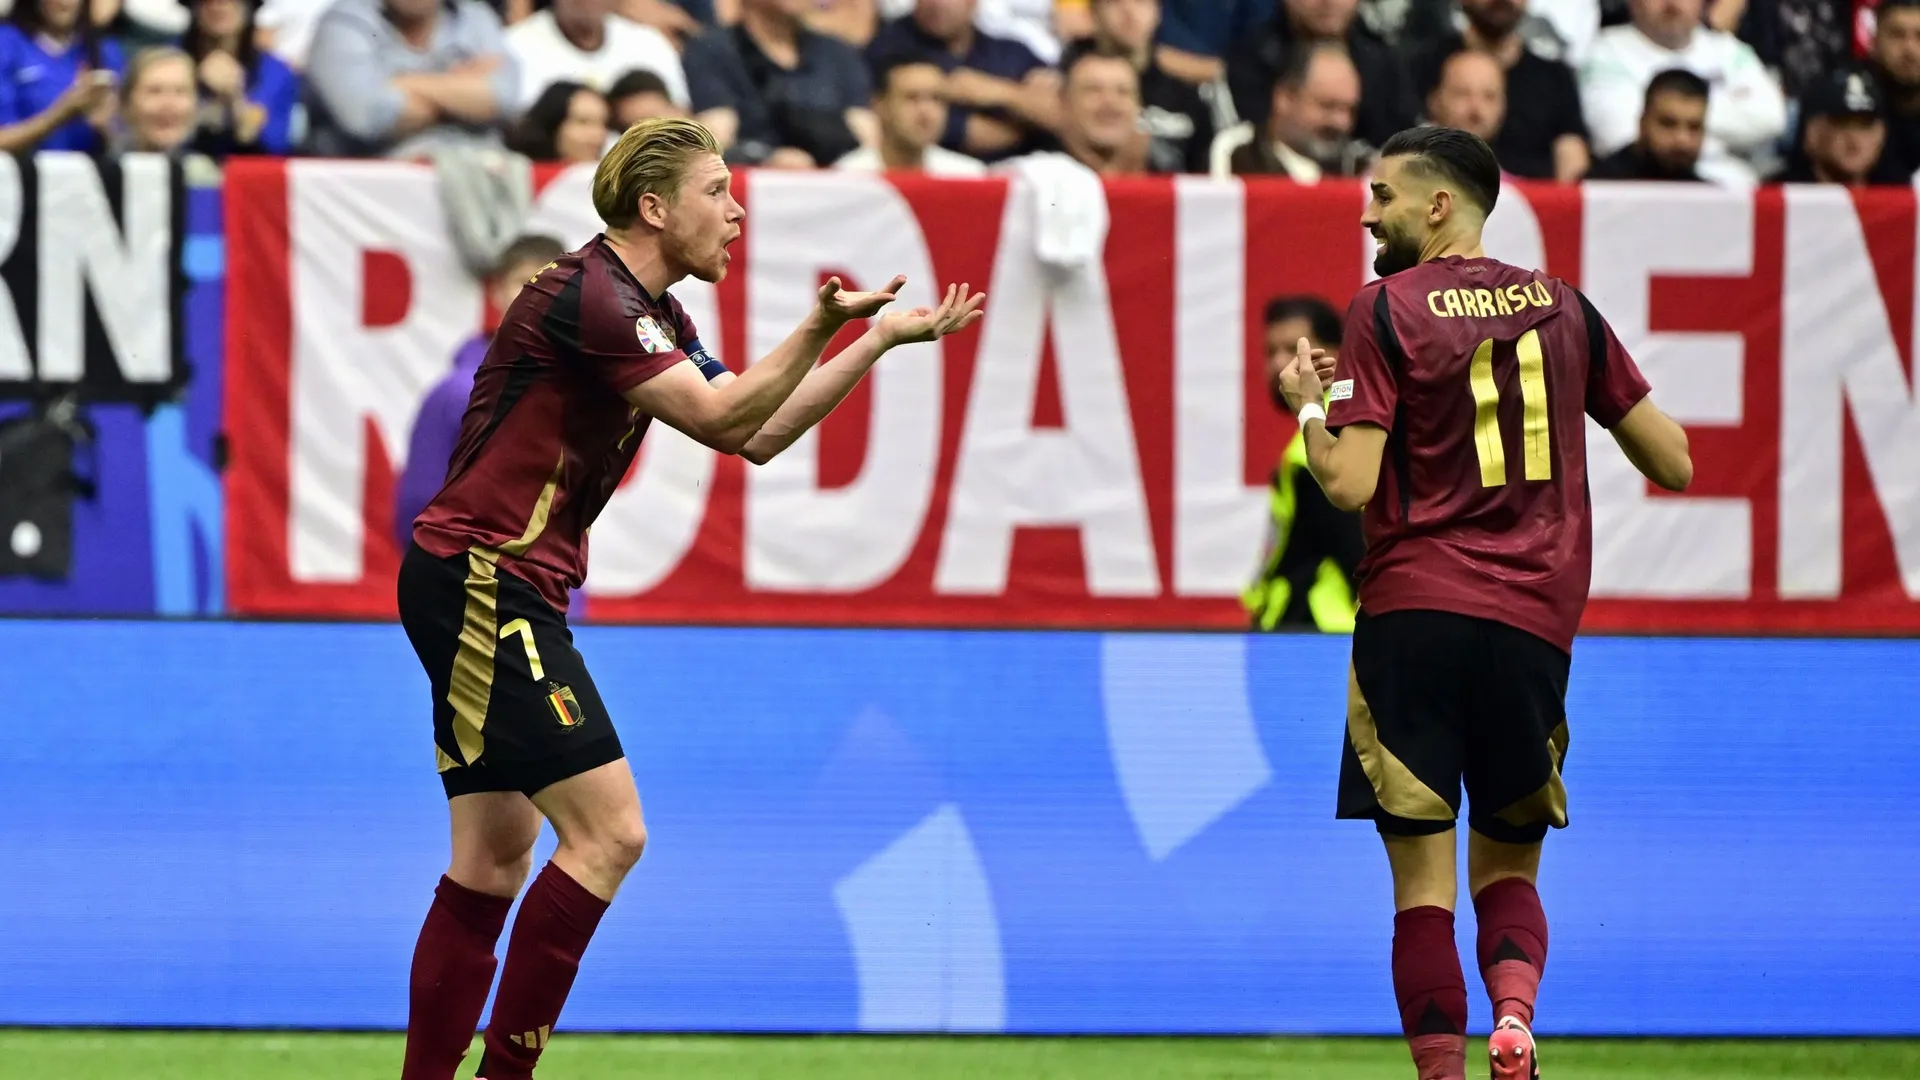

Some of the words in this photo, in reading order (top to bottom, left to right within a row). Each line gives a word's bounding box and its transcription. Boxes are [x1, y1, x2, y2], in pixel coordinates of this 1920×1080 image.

[0, 150, 172, 382] N
[1427, 280, 1553, 317] CARRASCO
[287, 157, 1920, 601] RDALEN
[1470, 329, 1552, 488] 11
[499, 618, 545, 681] 7
